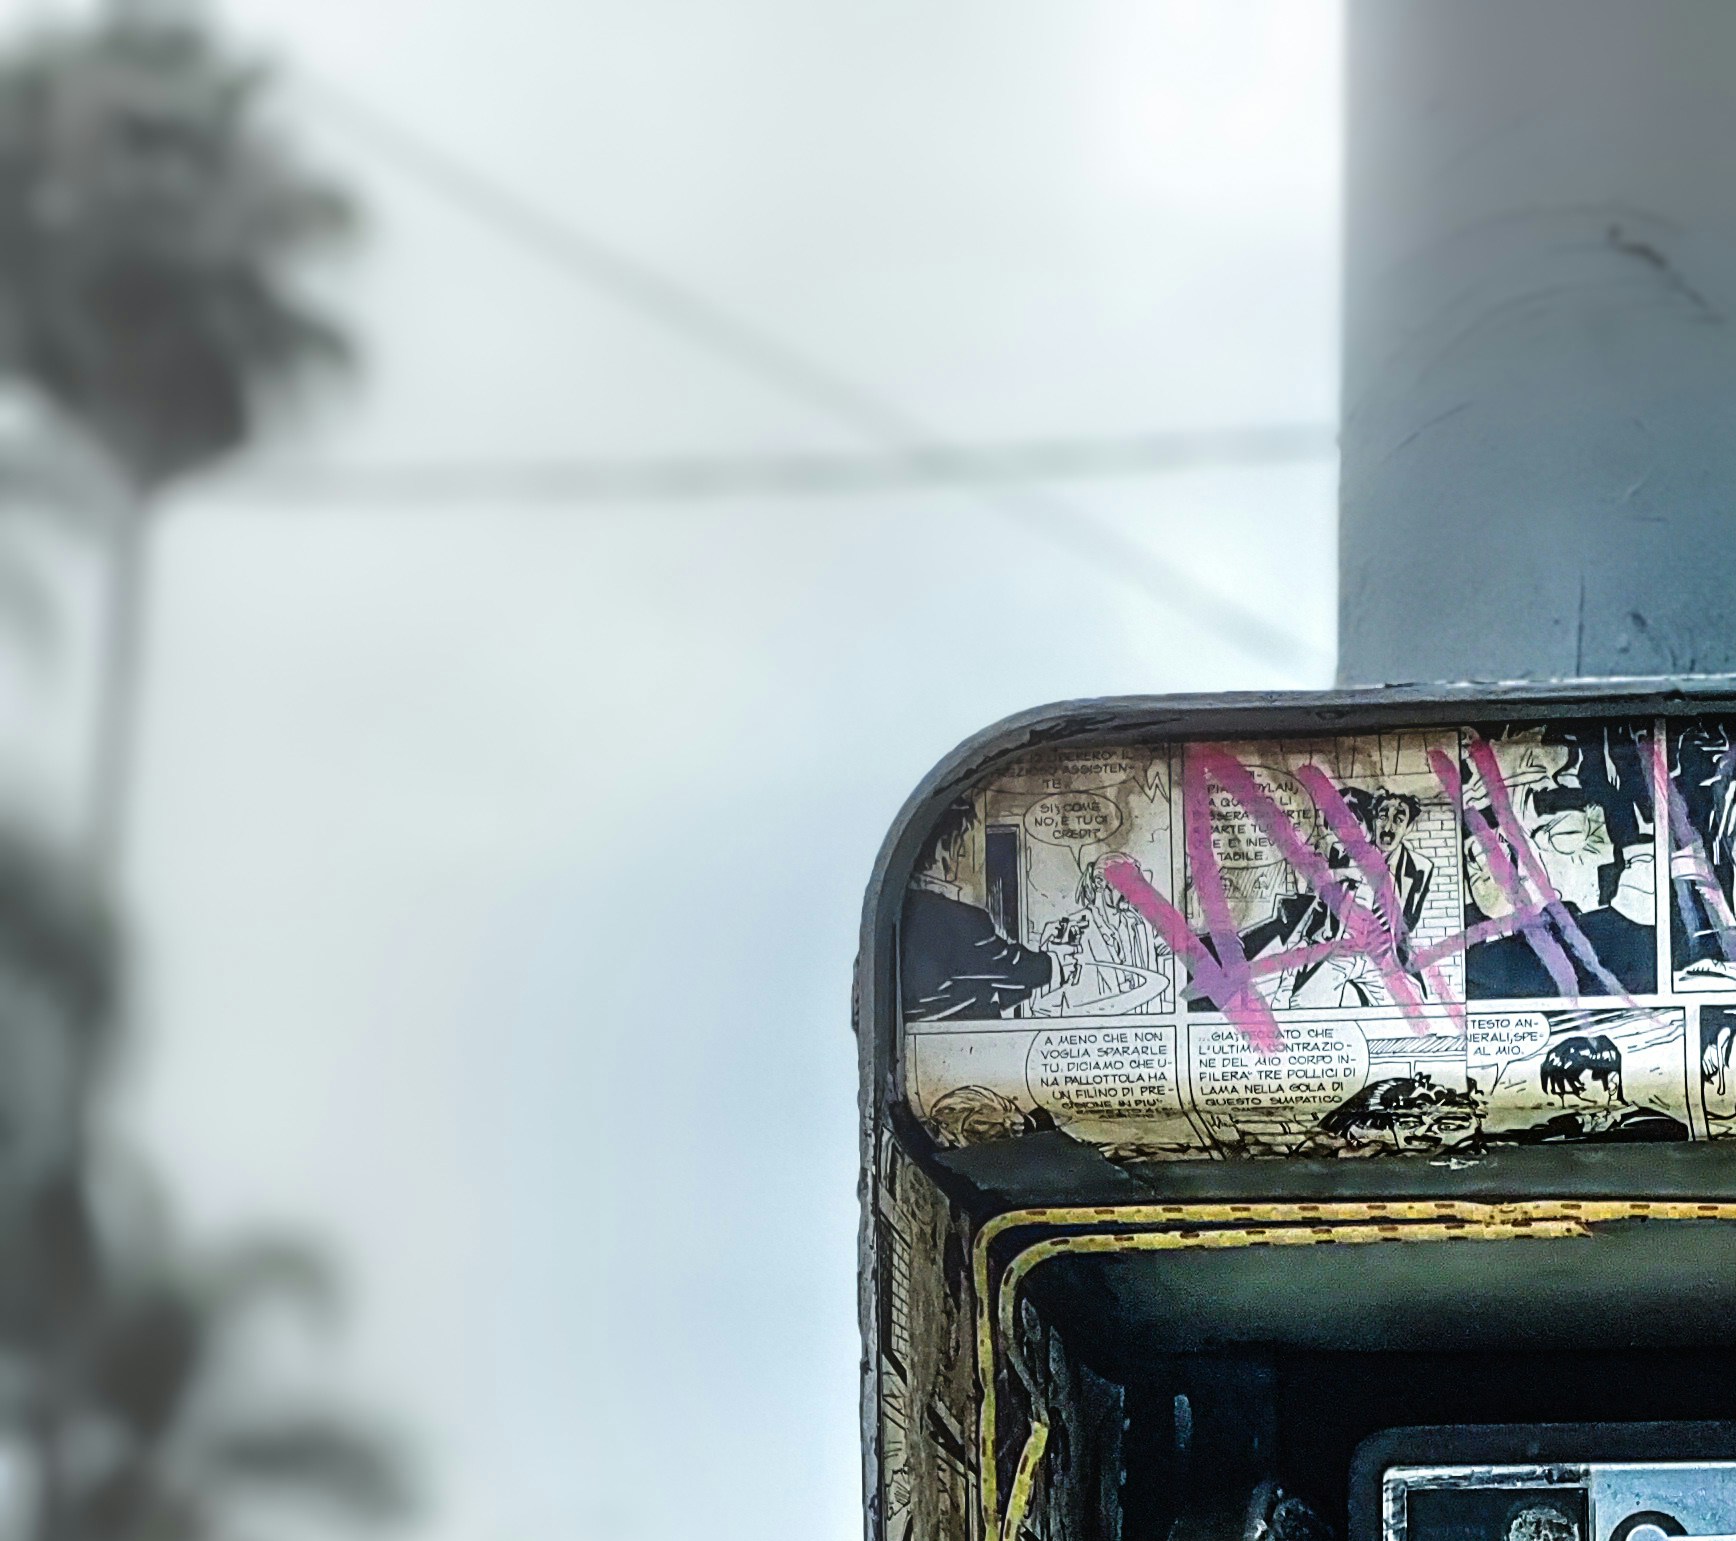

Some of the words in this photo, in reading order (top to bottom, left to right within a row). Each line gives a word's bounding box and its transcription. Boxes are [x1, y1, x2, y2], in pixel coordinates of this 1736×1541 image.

[1045, 1037, 1053, 1045] A
[1058, 1035, 1097, 1046] MENO
[1103, 1033, 1128, 1043] CHE
[1135, 1032, 1162, 1042] NON
[1041, 1049, 1090, 1059] VOGLIA
[1098, 1045, 1167, 1056] SPARARLE
[1201, 1085, 1239, 1095] LAMA
[1245, 1083, 1285, 1094] NELLA
[1289, 1083, 1325, 1092] GOLA
[1332, 1082, 1343, 1091] DI
